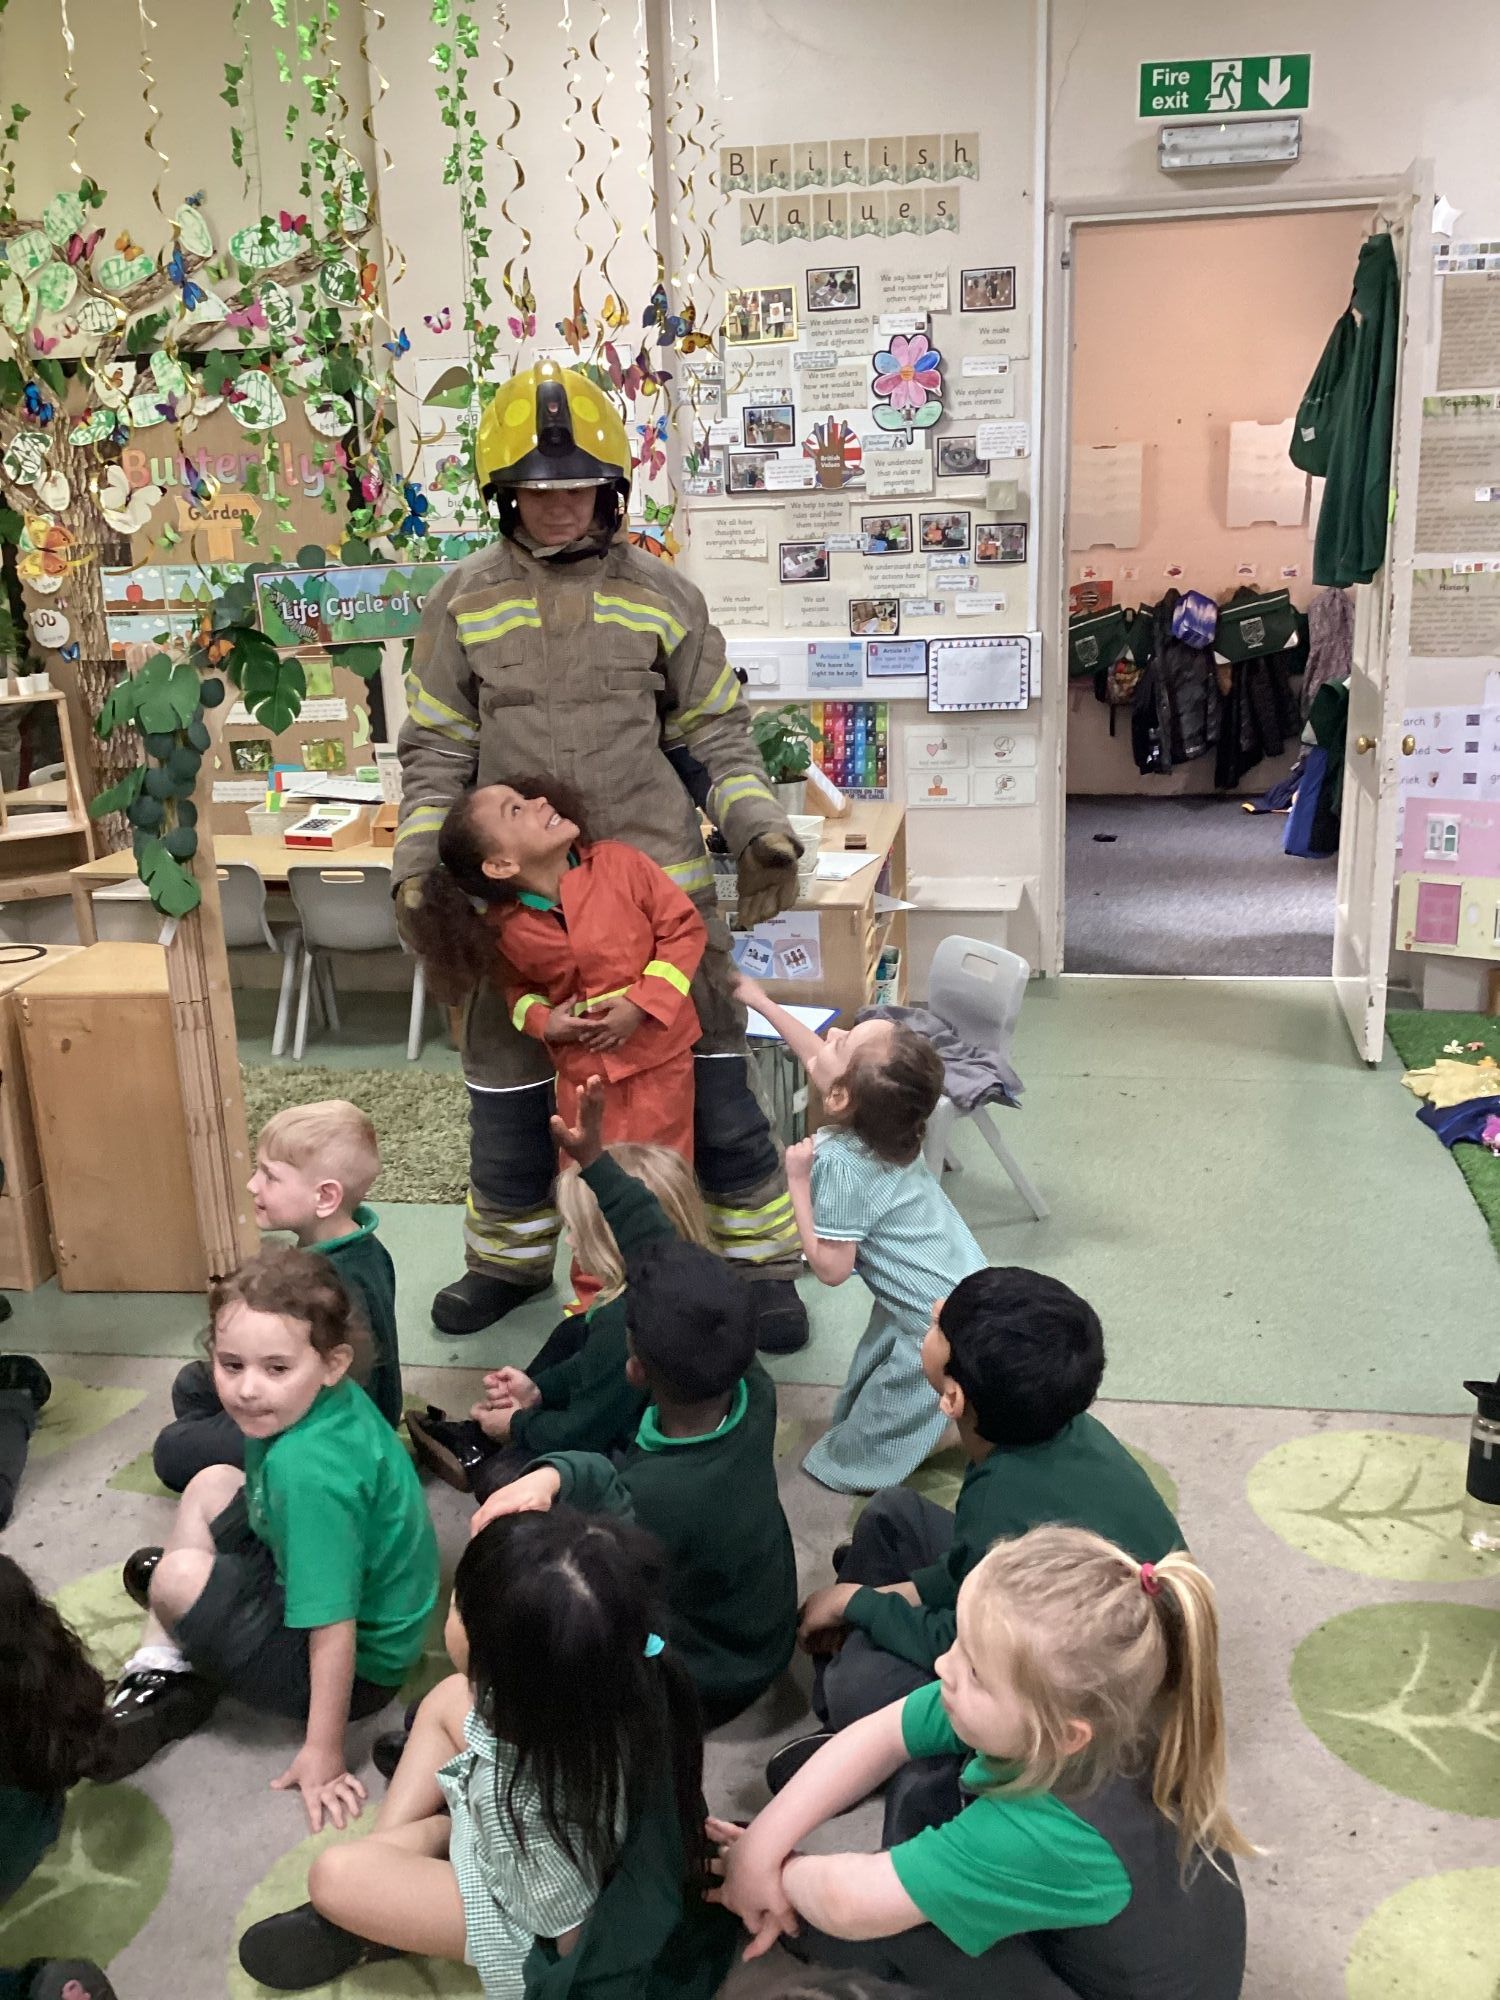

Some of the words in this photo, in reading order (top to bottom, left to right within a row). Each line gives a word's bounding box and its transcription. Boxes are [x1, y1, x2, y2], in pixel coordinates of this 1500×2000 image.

[1152, 68, 1191, 86] Fire
[1152, 91, 1189, 109] exit
[729, 139, 969, 177] British
[748, 199, 947, 226] Values
[880, 273, 891, 281] We
[808, 370, 819, 379] We
[874, 459, 885, 467] We
[790, 501, 801, 509] We
[188, 503, 250, 521] Grden
[716, 518, 726, 526] We
[863, 562, 873, 571] We
[1439, 583, 1470, 593] History
[280, 597, 319, 624] Life
[326, 594, 384, 621] Cycle
[390, 590, 411, 616] of
[846, 669, 858, 678] safe
